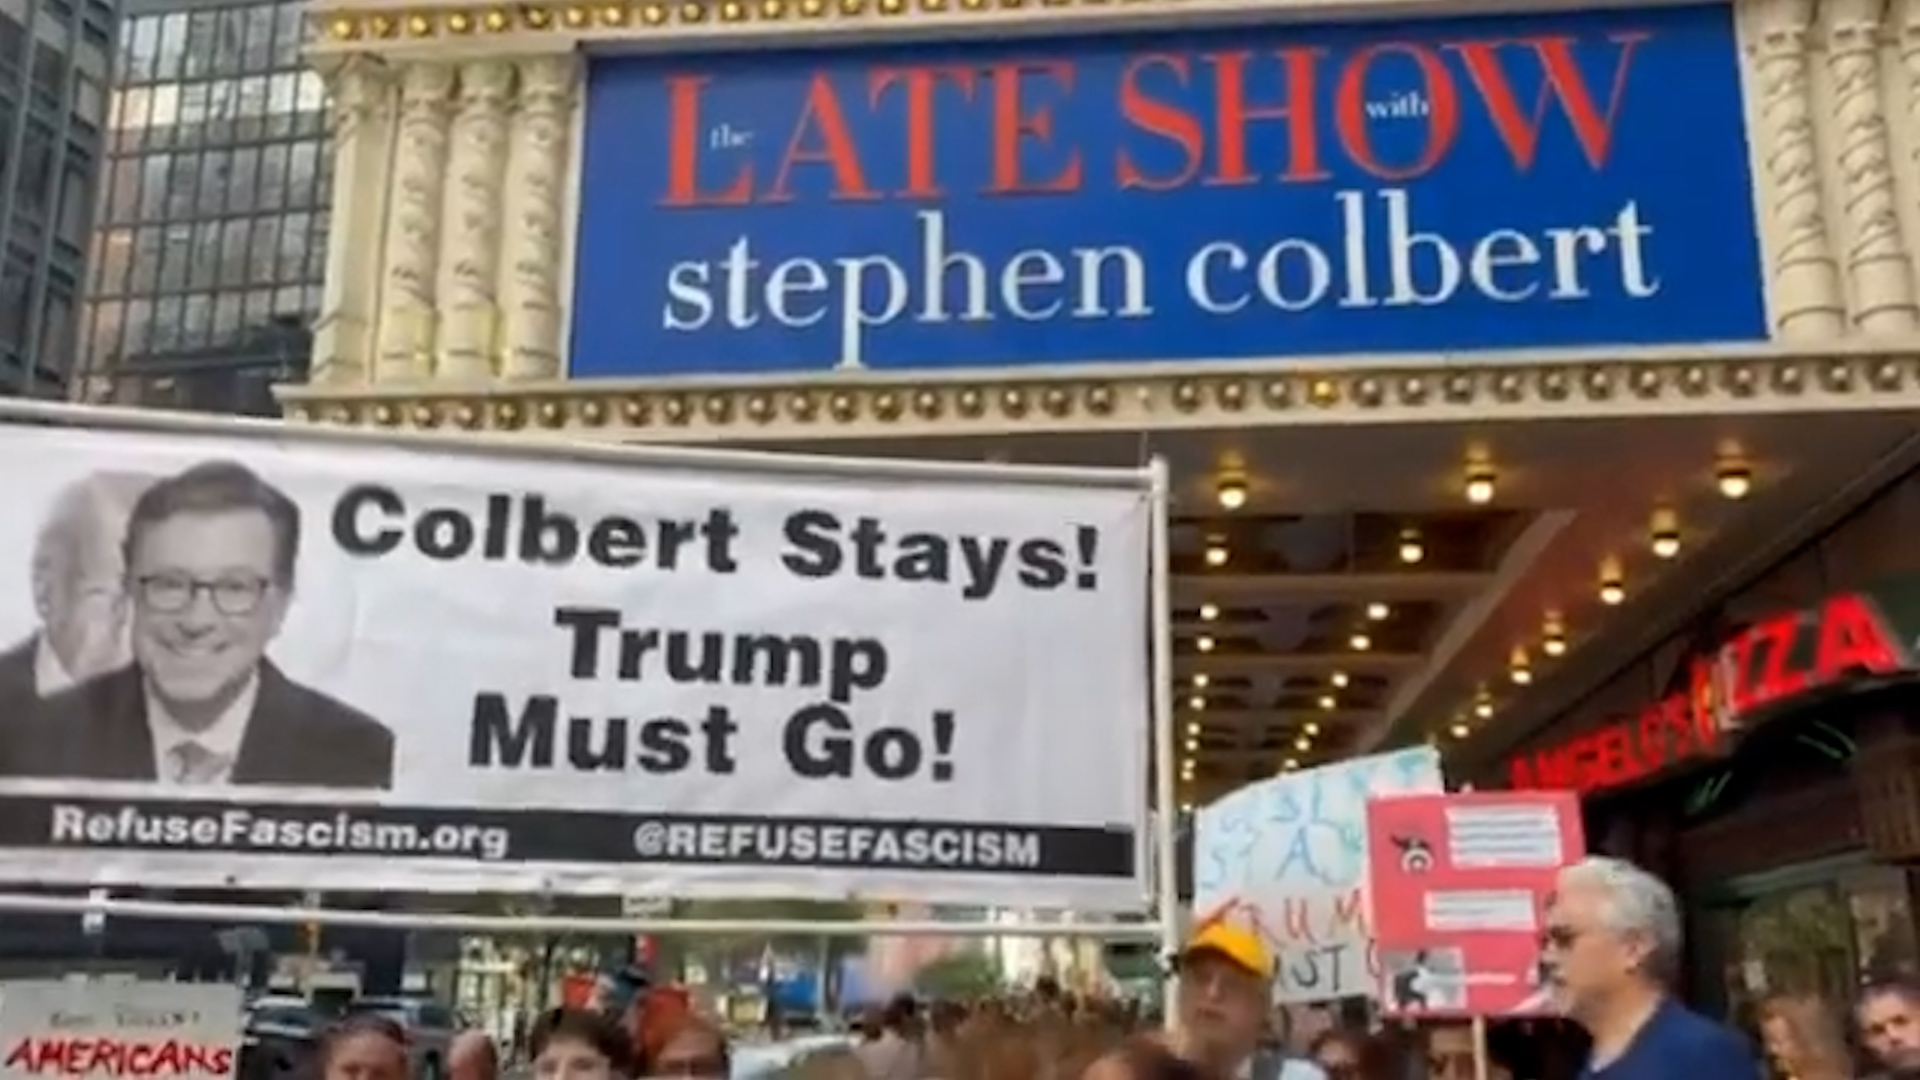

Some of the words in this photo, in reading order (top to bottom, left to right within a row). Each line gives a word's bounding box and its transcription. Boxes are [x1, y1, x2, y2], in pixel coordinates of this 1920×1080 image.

[656, 61, 1083, 210] LATE
[1114, 32, 1655, 192] SHOW
[711, 124, 754, 150] the
[1365, 91, 1430, 119] with
[662, 210, 1154, 370] stephen
[1185, 188, 1660, 313] colbert
[330, 484, 740, 573] Colbert
[781, 510, 1100, 600] Stays!
[554, 608, 889, 703] Trump
[469, 692, 738, 776] Must
[782, 704, 956, 781] Go!
[50, 804, 509, 859] RefuseFascism.org
[633, 821, 1041, 867] @REFUSEFASCISM
[5, 1035, 233, 1076] AMERICANS
